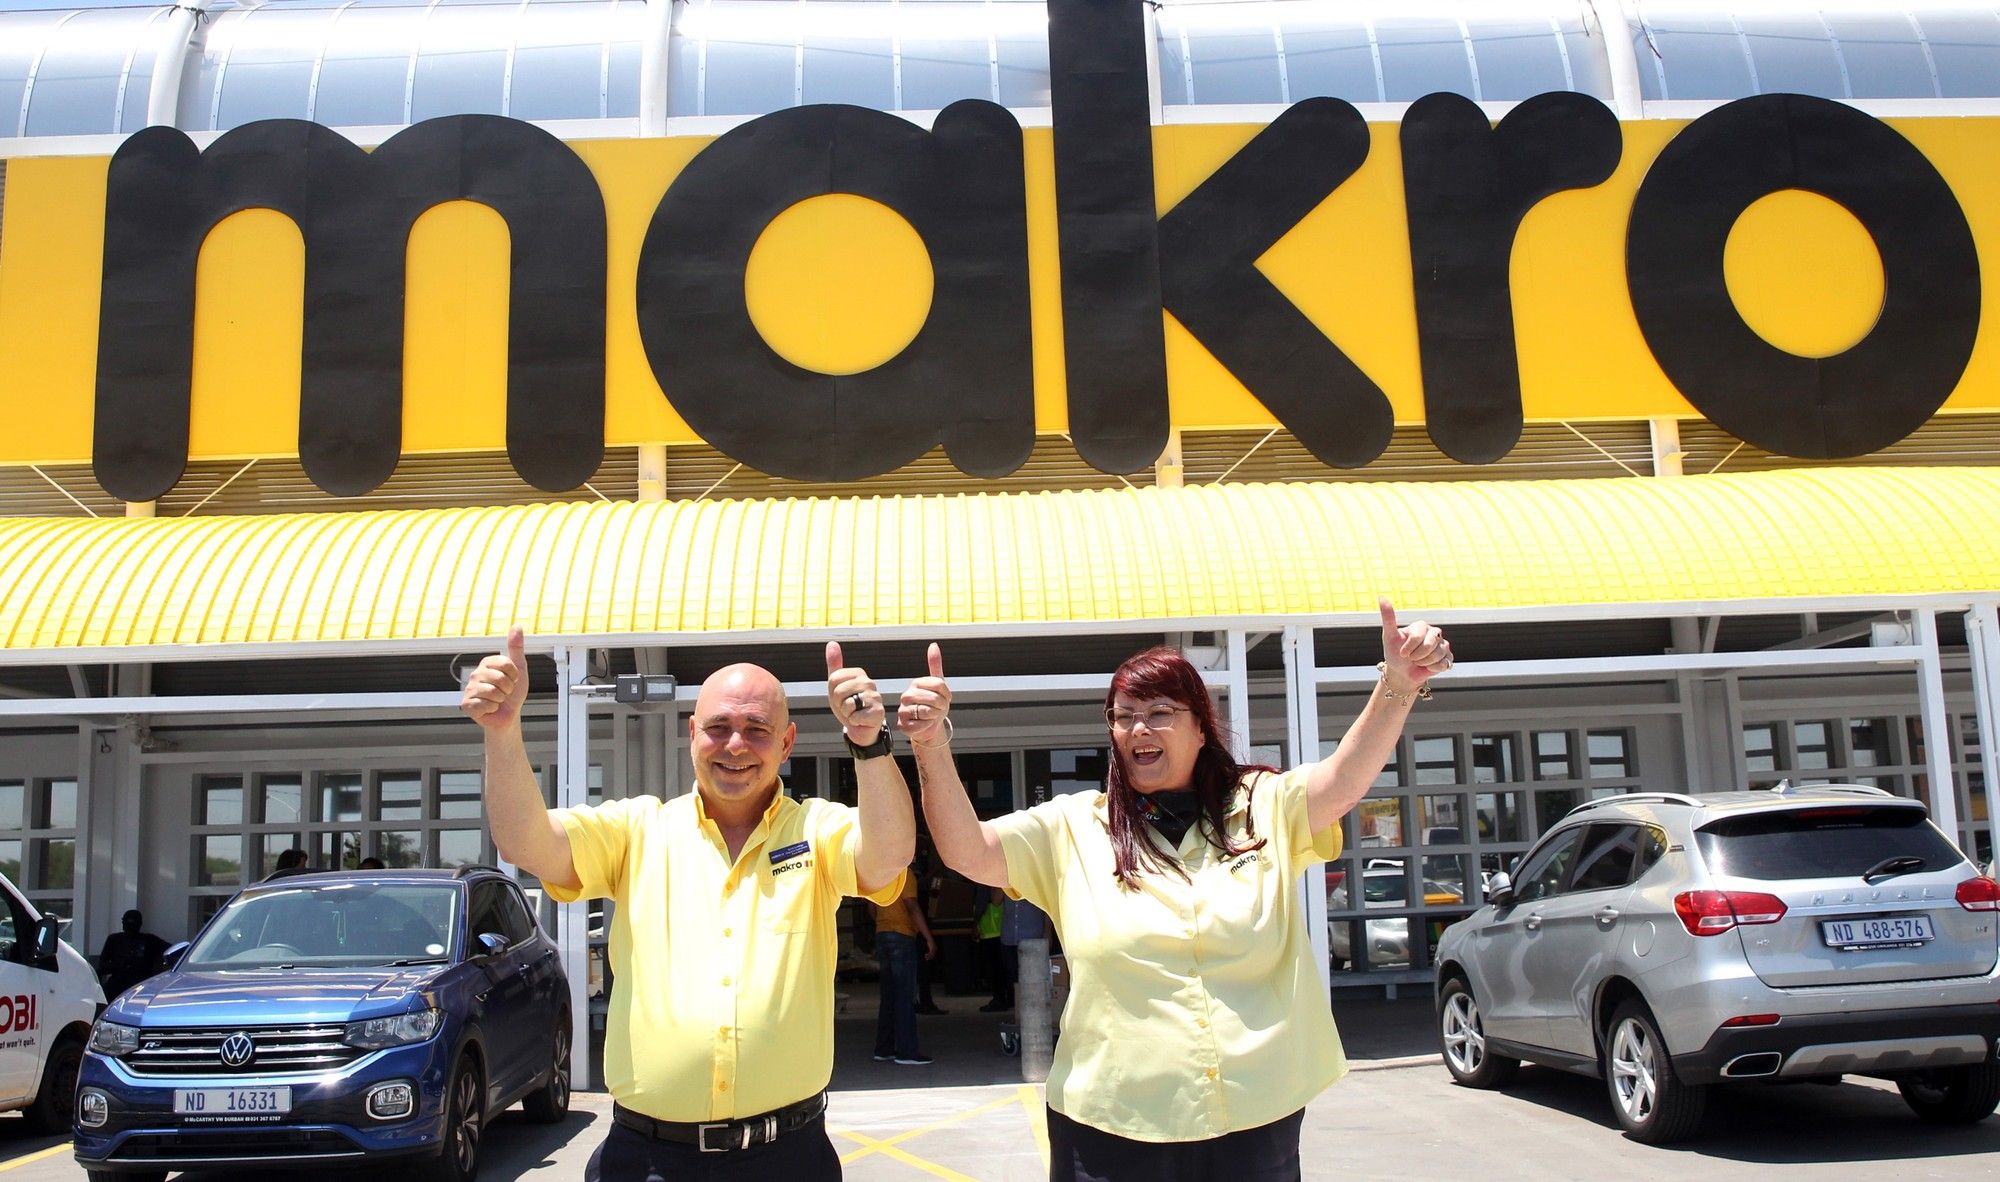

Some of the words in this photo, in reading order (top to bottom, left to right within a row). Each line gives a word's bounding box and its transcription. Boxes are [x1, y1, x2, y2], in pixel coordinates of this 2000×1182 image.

[92, 0, 1981, 503] makro
[772, 861, 803, 877] makro
[1230, 854, 1257, 875] makro
[1812, 887, 1935, 905] HAVAL
[1832, 923, 1853, 942] ND
[1863, 919, 1924, 941] 488-576
[185, 1092, 206, 1111] ND
[227, 1091, 278, 1110] 16331
